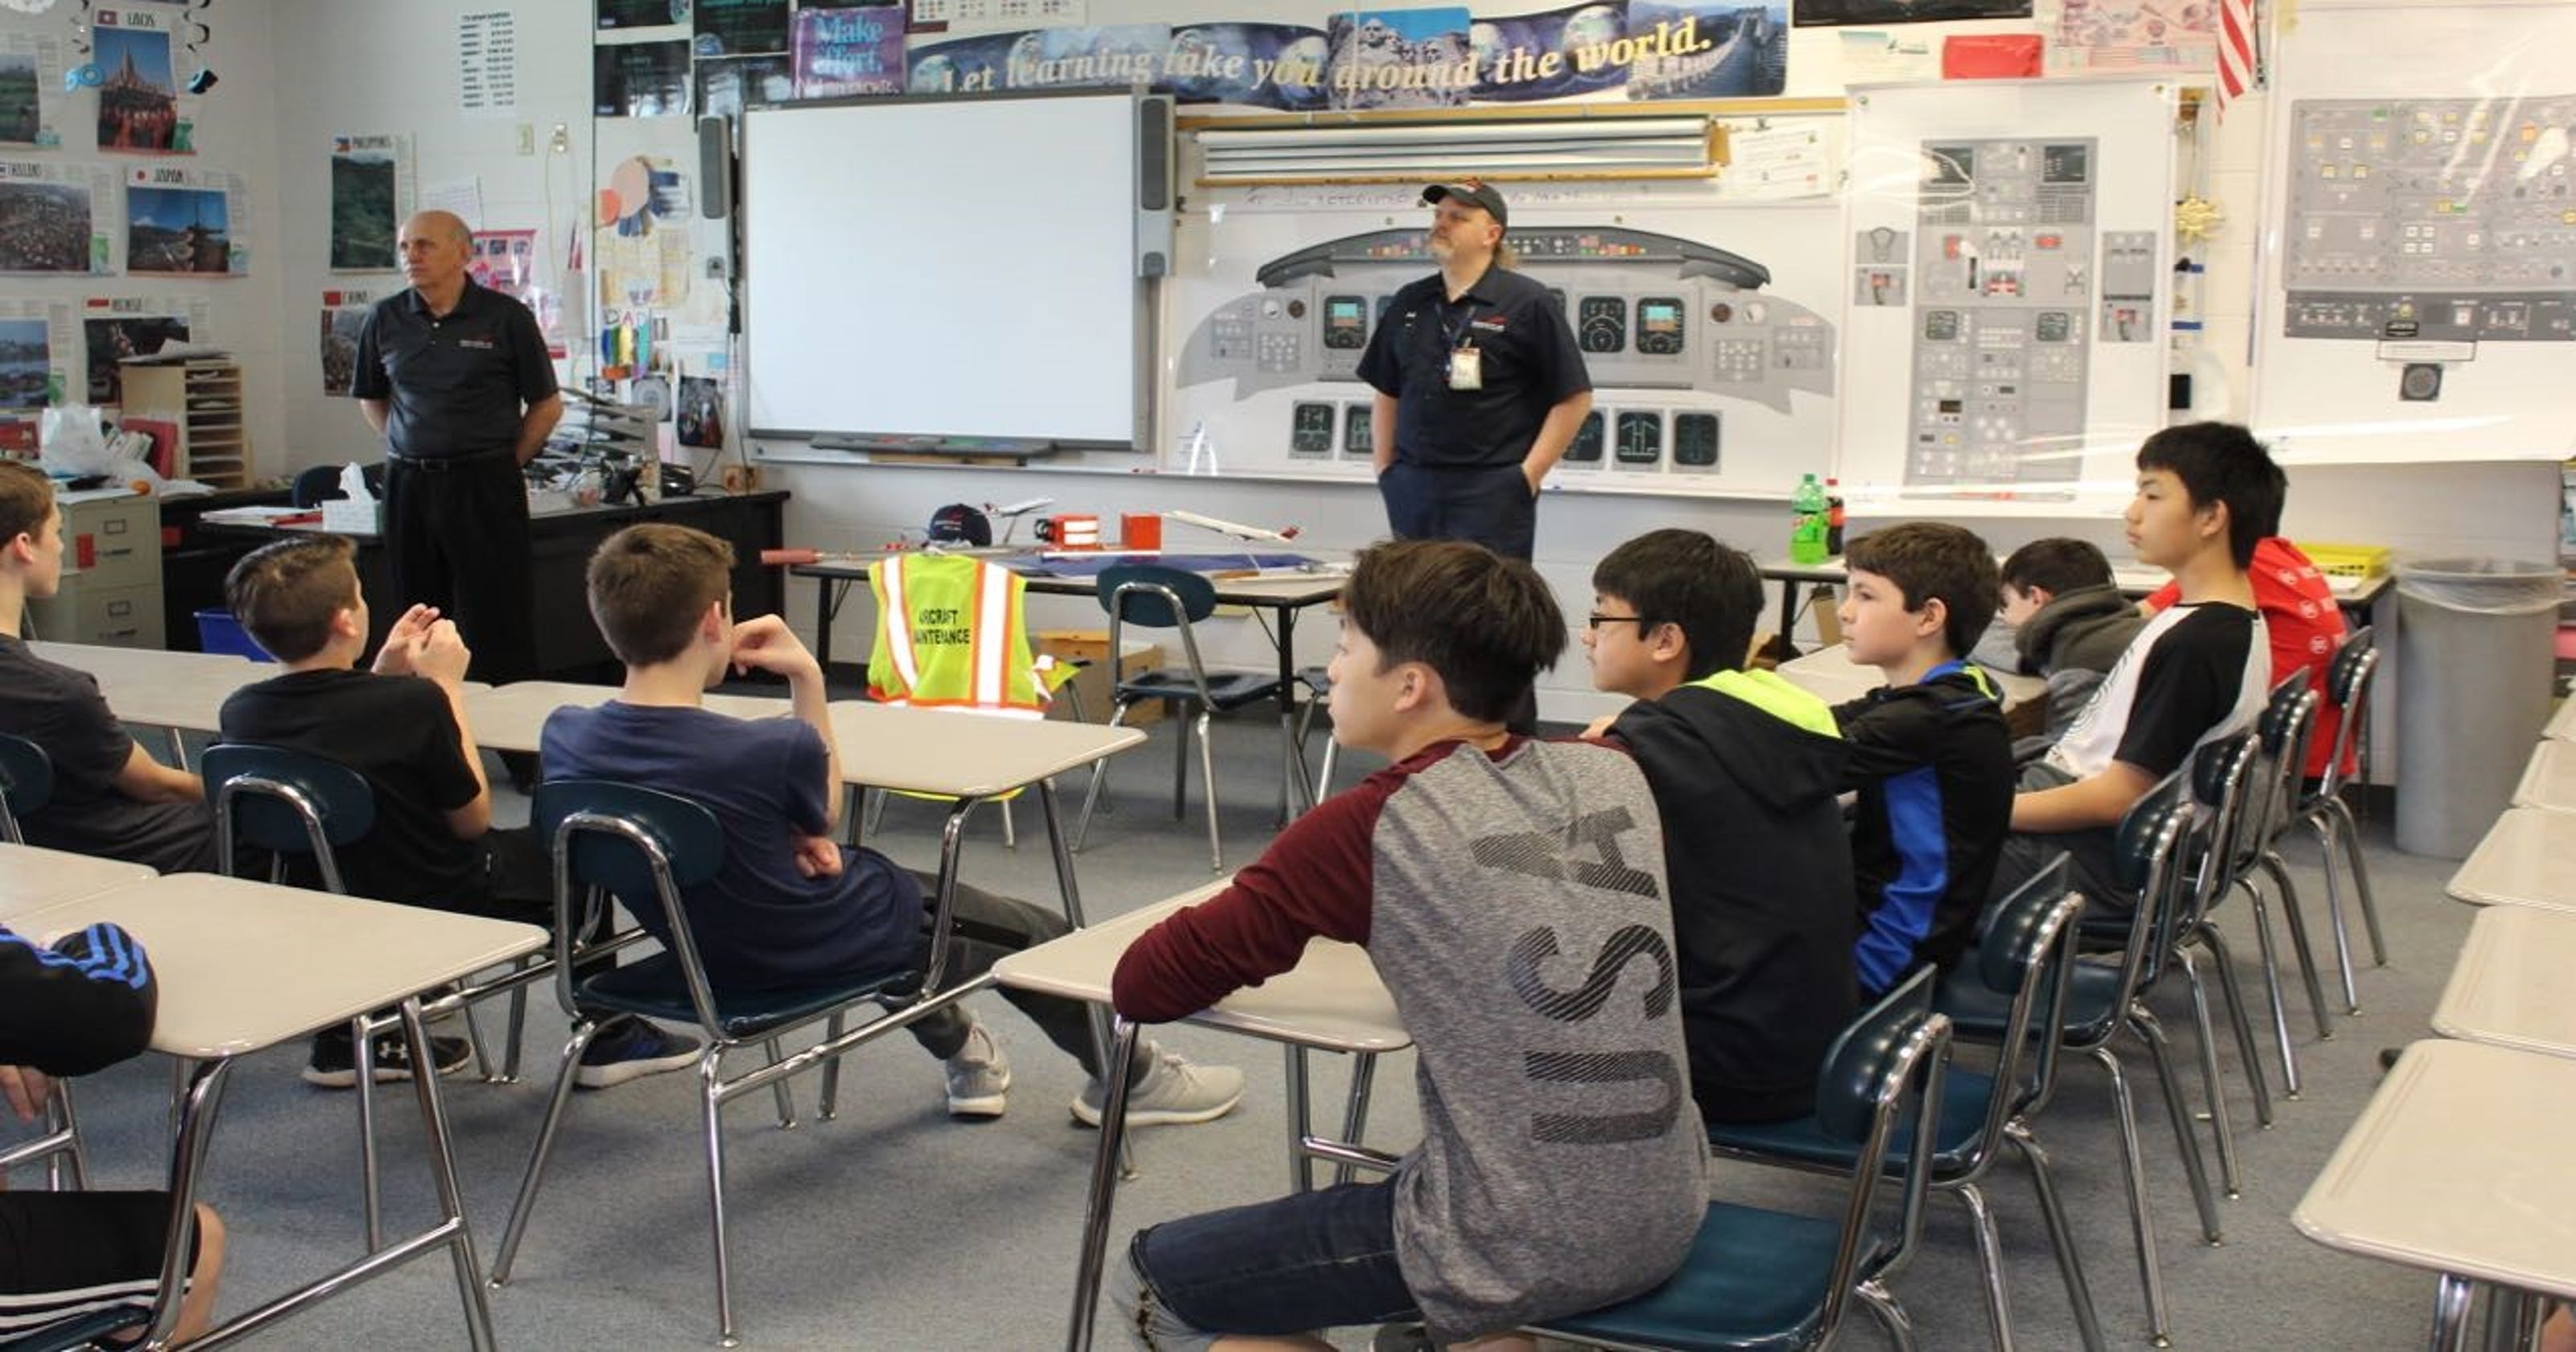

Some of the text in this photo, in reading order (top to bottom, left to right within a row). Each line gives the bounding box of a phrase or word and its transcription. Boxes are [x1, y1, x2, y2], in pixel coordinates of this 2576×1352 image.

[1007, 47, 1154, 87] learning
[1249, 56, 1322, 90] you
[1334, 50, 1480, 90] around
[1495, 46, 1561, 84] the
[1574, 15, 1712, 72] world.
[1469, 806, 1682, 1142] USA
